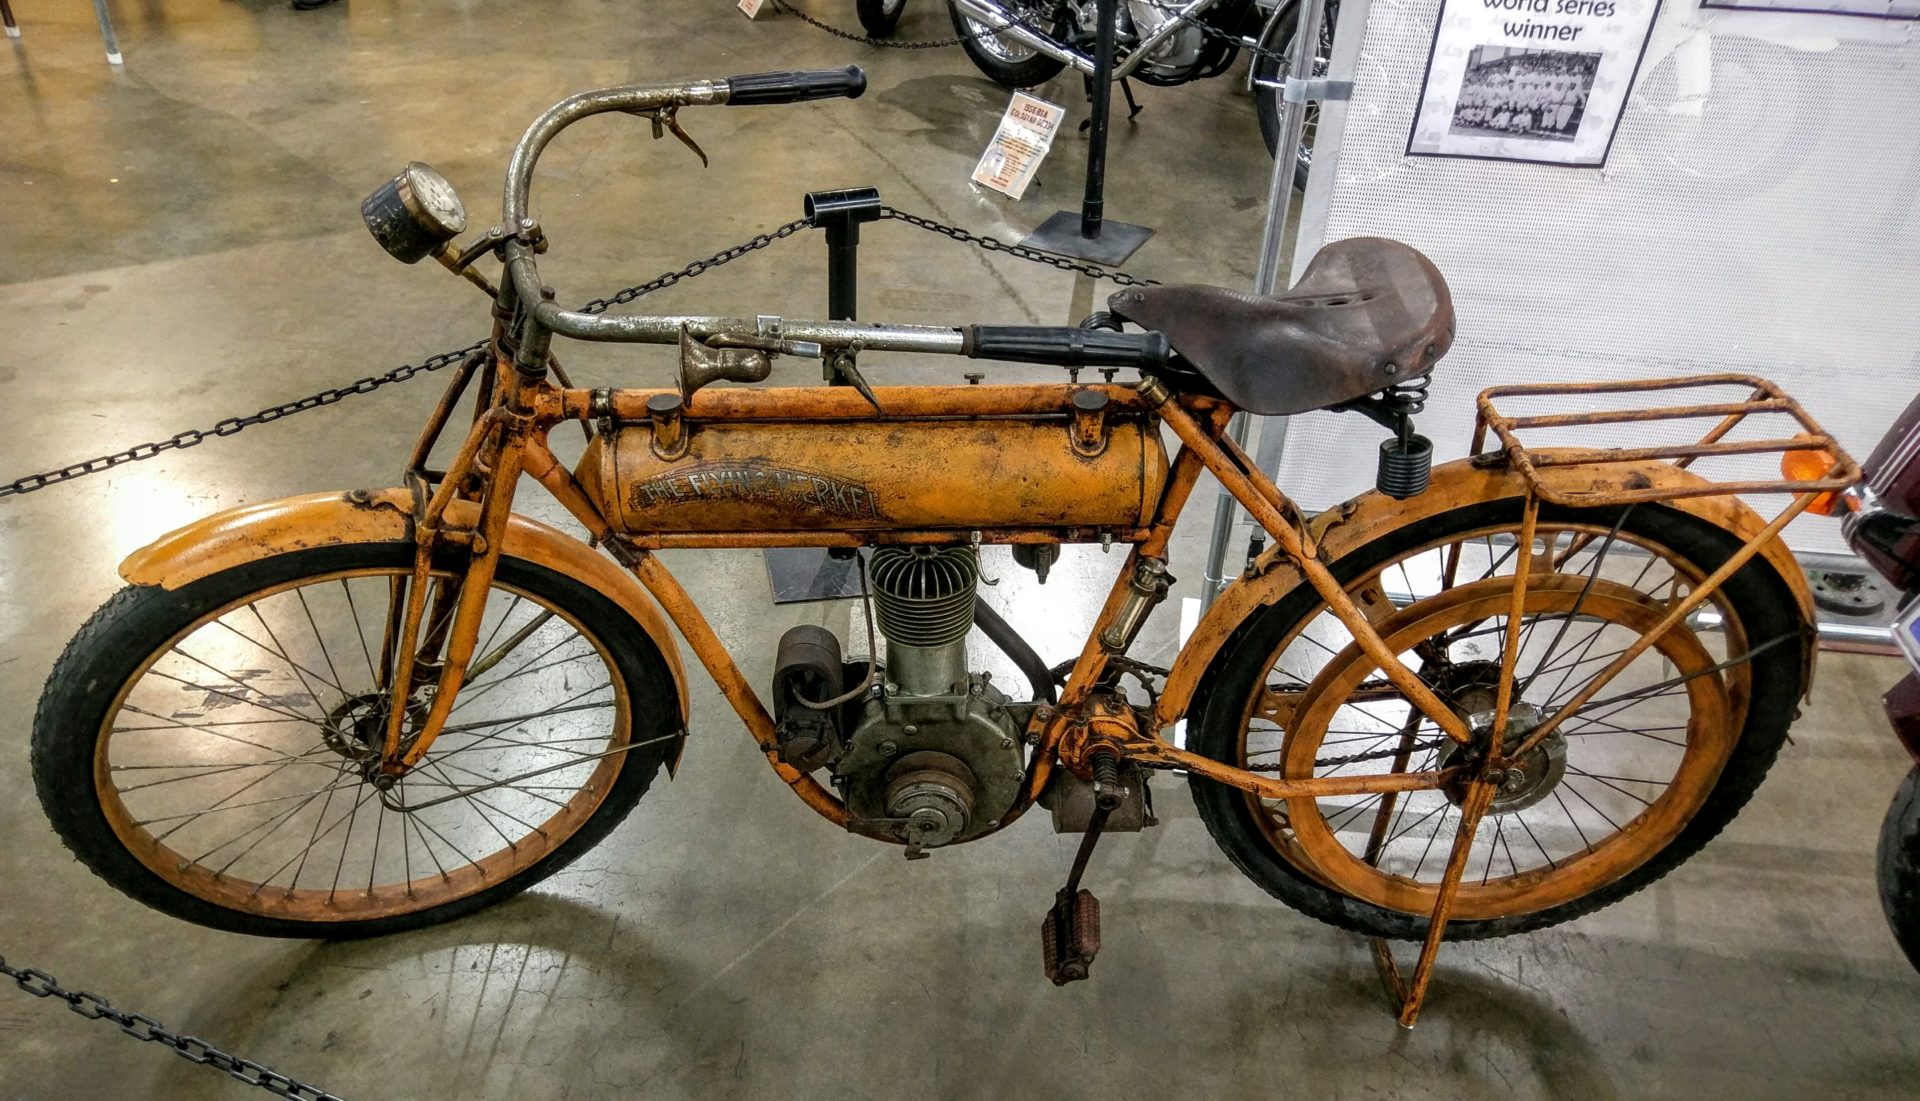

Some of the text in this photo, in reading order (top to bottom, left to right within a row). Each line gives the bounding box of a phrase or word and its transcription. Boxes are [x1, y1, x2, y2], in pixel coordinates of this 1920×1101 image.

[1555, 0, 1616, 17] series
[1504, 18, 1583, 41] winner
[1036, 108, 1048, 119] BSA
[640, 478, 684, 501] THE
[687, 471, 764, 499] FLYIN
